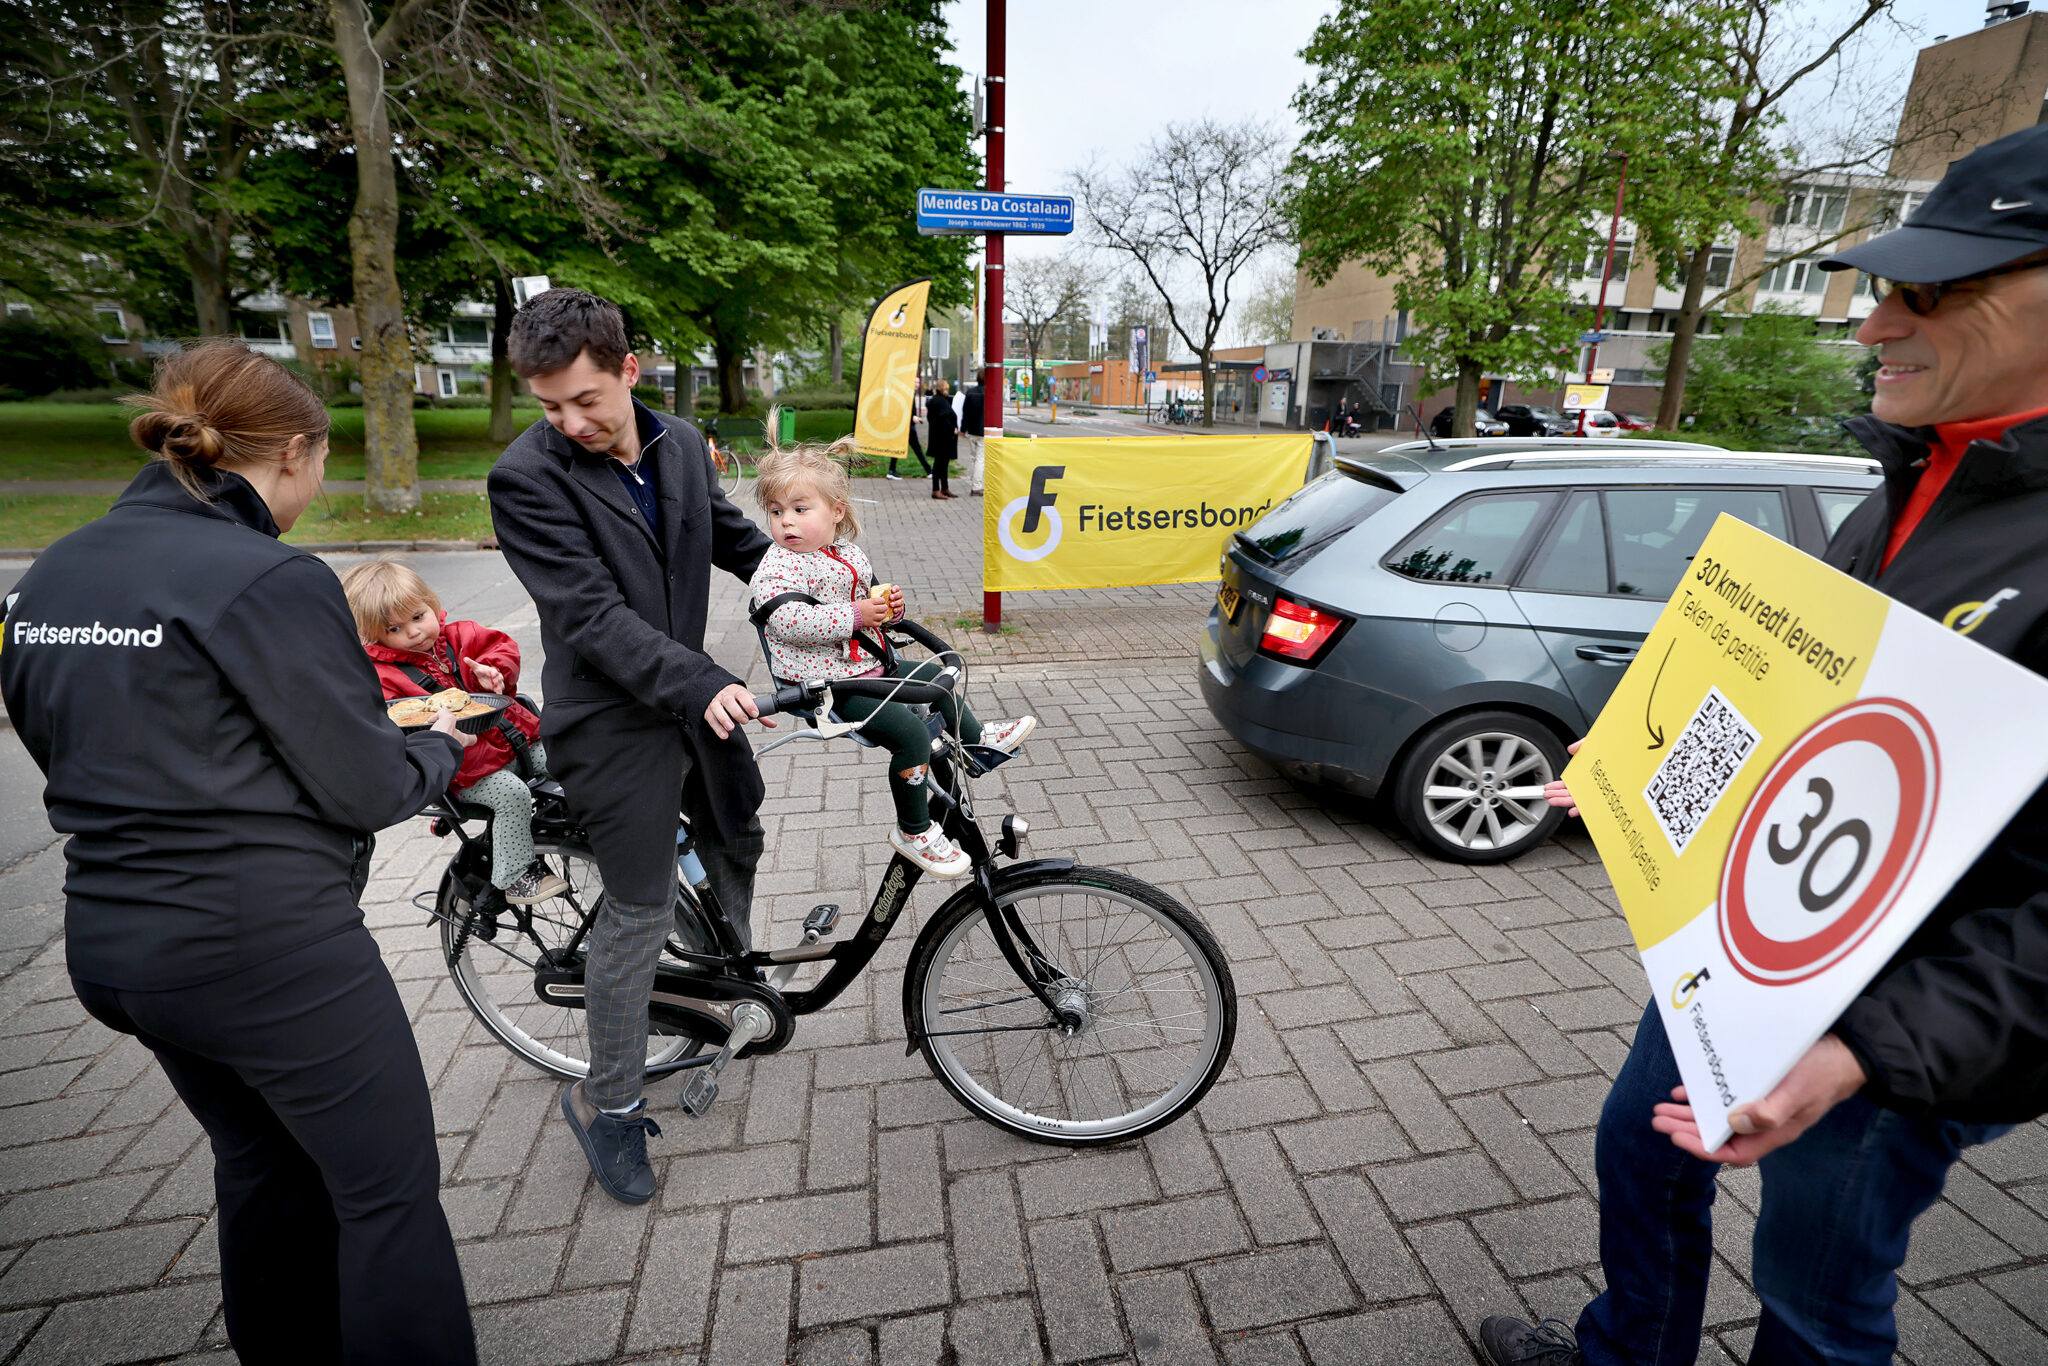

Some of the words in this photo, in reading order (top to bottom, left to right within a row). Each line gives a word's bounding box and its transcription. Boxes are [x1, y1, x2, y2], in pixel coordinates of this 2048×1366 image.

[923, 195, 978, 211] Mendes
[981, 198, 999, 212] Da
[1002, 199, 1069, 215] Costalaan
[948, 219, 968, 227] Joseph
[870, 328, 918, 339] Fietsersbond
[13, 621, 163, 648] Fietsersbond
[1678, 590, 1713, 633] Teken
[1711, 620, 1730, 646] de
[1722, 635, 1770, 681] petitie
[1697, 557, 1721, 587] 30
[1714, 569, 1755, 614] km/u
[1749, 599, 1789, 638] redt
[1781, 616, 1857, 686] levens!
[1590, 759, 1660, 892] fietsersbond.nl/petitie
[1768, 777, 1871, 913] 30
[1689, 1002, 1737, 1108] Fietsersbond
